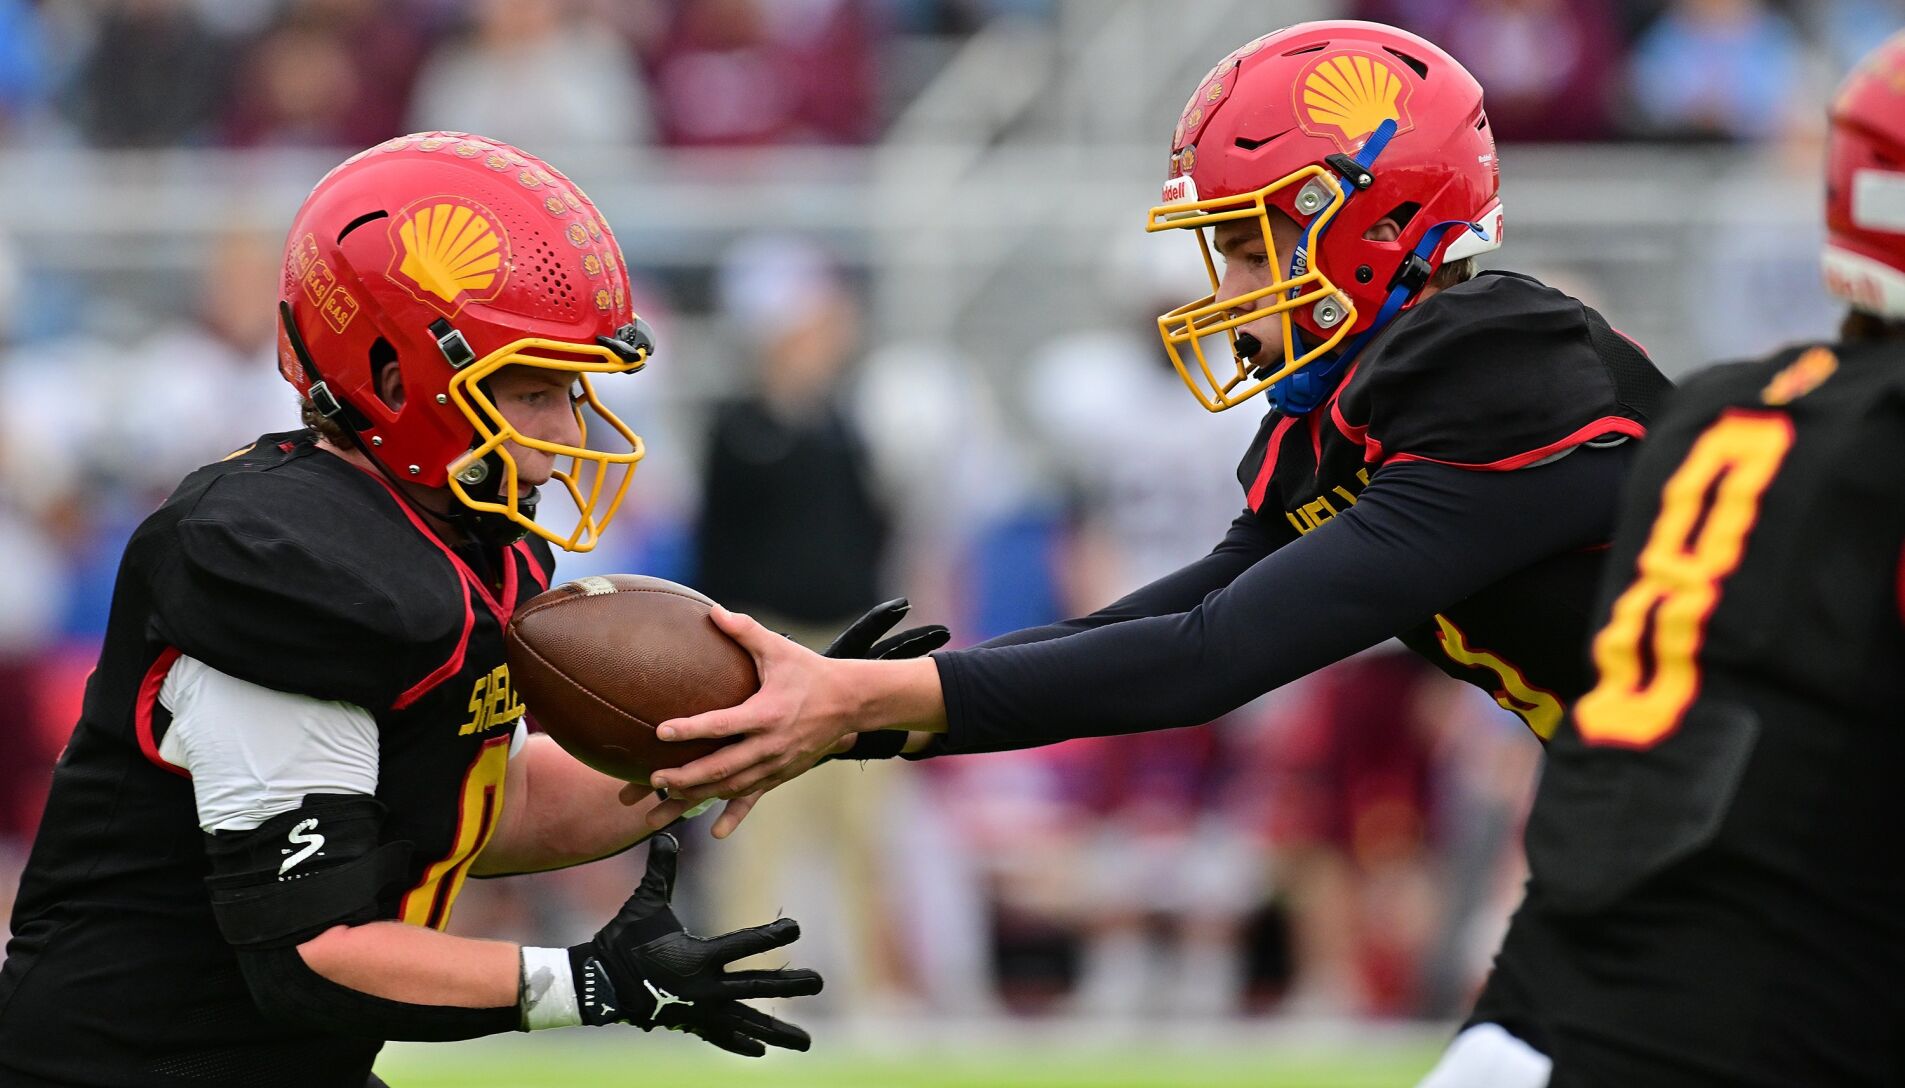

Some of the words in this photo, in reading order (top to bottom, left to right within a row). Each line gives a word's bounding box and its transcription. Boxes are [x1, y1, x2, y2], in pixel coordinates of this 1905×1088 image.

[1571, 405, 1797, 751] 8
[458, 663, 526, 736] SHELL
[584, 965, 596, 1007] JORDAN
